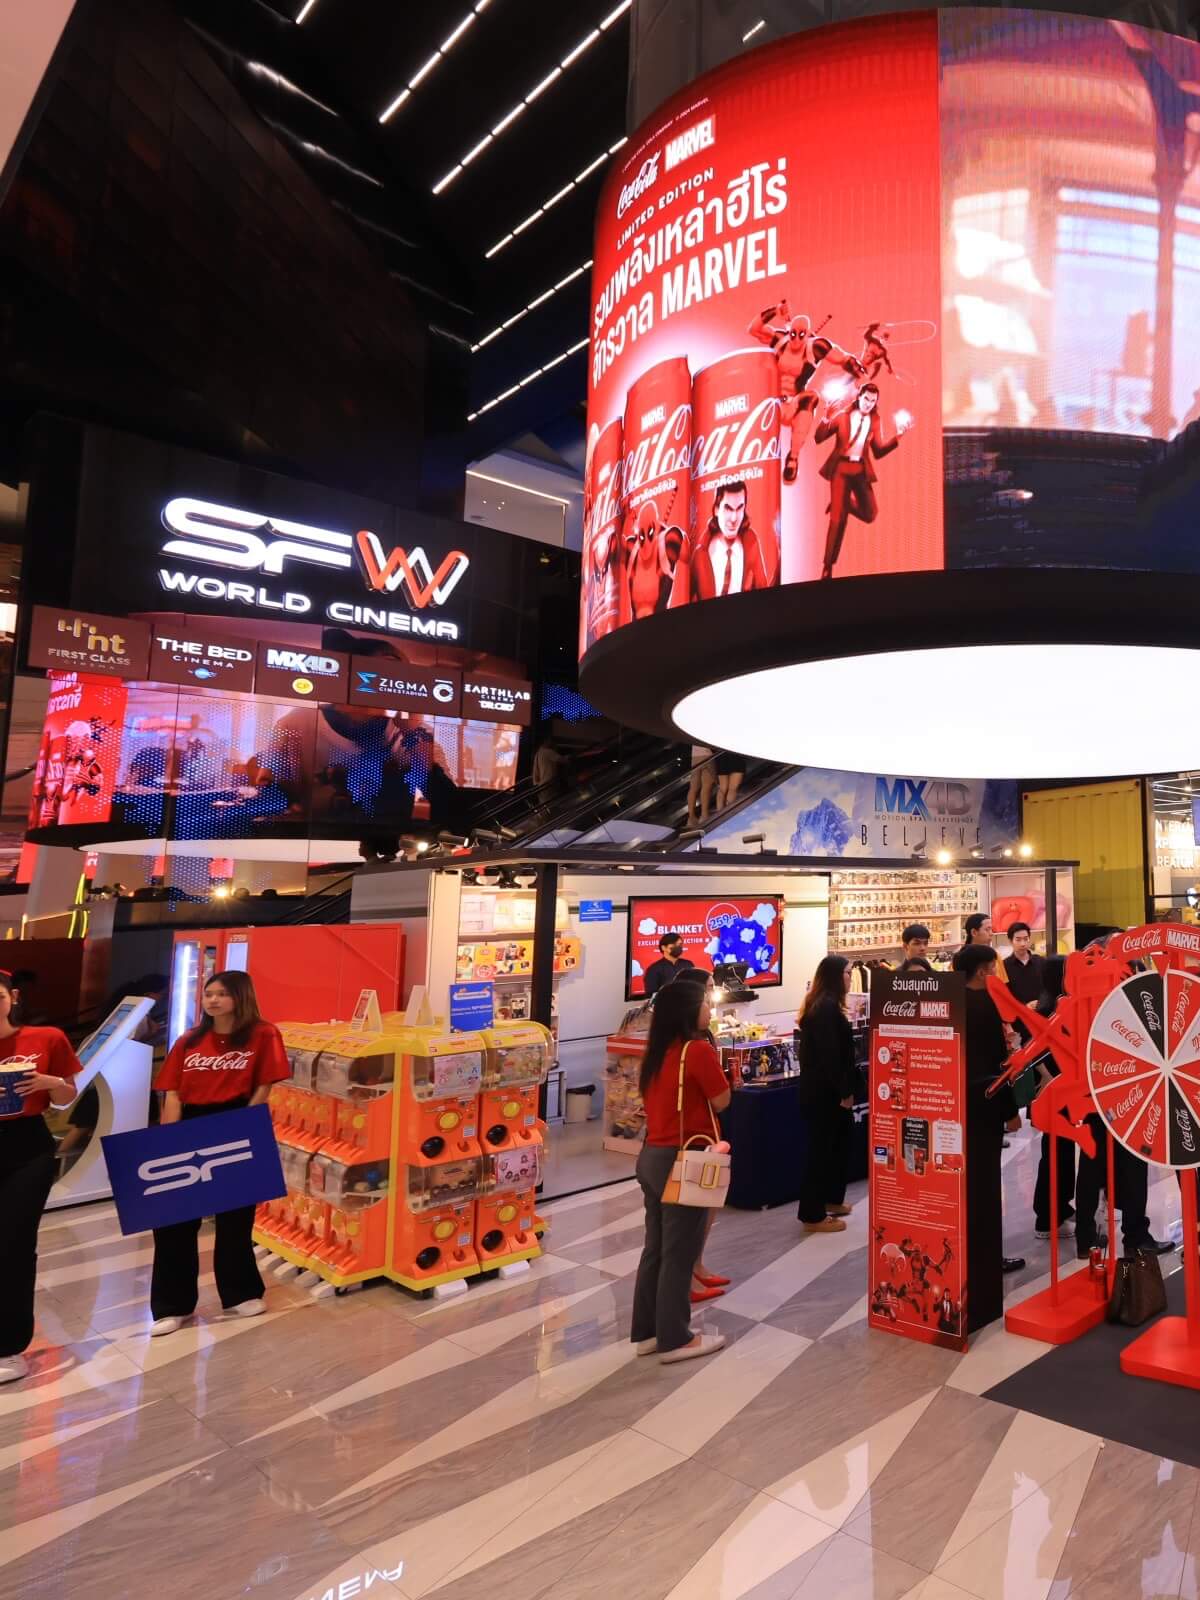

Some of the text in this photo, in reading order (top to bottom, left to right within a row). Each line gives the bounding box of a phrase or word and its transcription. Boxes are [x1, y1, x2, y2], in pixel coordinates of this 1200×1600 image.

[664, 114, 716, 174] MARVEL
[617, 167, 715, 251] LIMITED EDITION
[660, 226, 788, 321] MARVEL
[157, 568, 460, 642] WORLD CINEMA
[48, 647, 130, 667] FIRST CLASS
[156, 637, 253, 663] THE BED
[172, 654, 235, 670] CINEMA
[267, 648, 340, 673] MX4D
[379, 678, 428, 693] ZIGMA
[464, 683, 531, 700] EARTHLAB
[874, 776, 972, 820] MX4D
[657, 924, 704, 935] BLANKET
[1122, 928, 1161, 952] Coca-Cola
[892, 976, 939, 996] ร่วมสนุกกับ
[882, 1001, 950, 1019] Coca-Cola MARVEL
[1140, 990, 1162, 1032] Coca-Cola
[1111, 1019, 1146, 1049] Coca-Cola
[184, 1051, 255, 1071] Coca-Cola
[1103, 1058, 1137, 1076] Coca-Cola
[1116, 1084, 1145, 1119] Coca-Cola
[1143, 1103, 1162, 1145] Coca-Cola
[1181, 1108, 1196, 1152] Coca-Cola
[138, 1139, 253, 1196] SF
